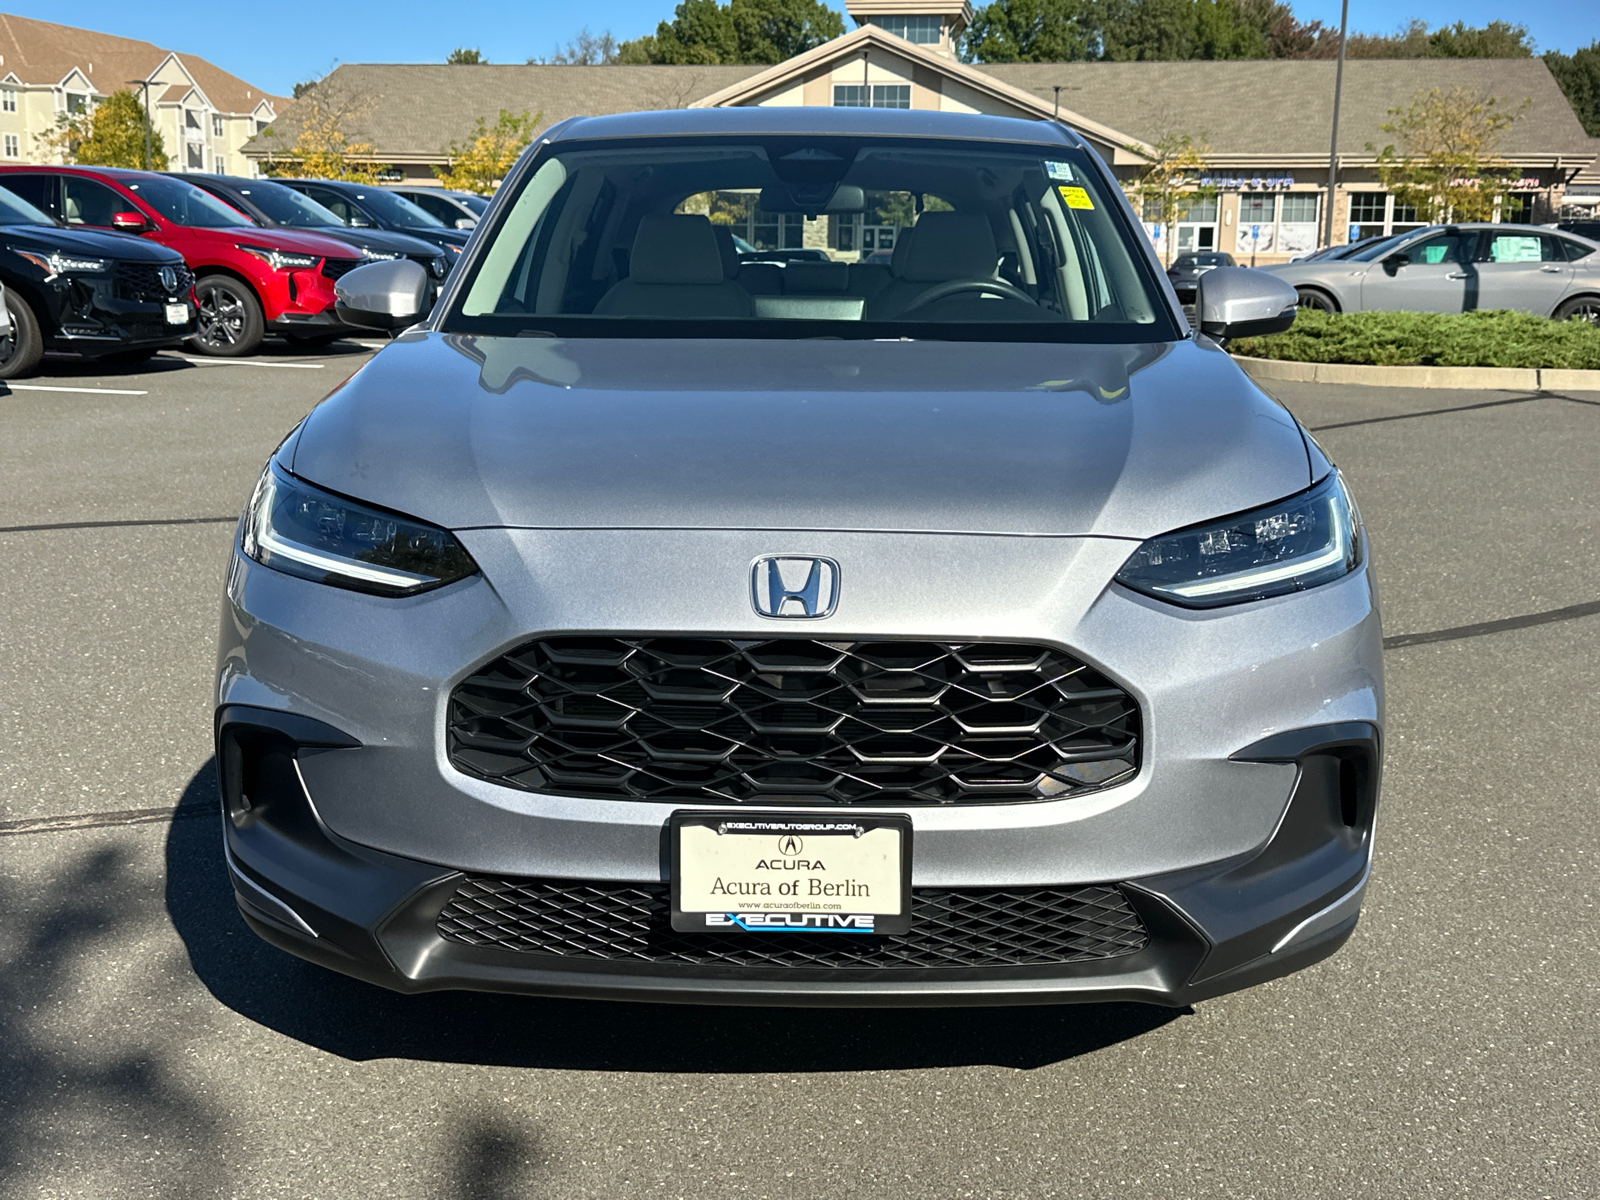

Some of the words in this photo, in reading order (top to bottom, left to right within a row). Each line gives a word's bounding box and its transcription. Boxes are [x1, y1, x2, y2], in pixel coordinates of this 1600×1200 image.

[1265, 170, 1294, 187] SPA
[726, 822, 857, 831] EXECUTIVEAUTOGROUP.COM
[755, 859, 826, 871] ACURA
[710, 877, 772, 896] Acura
[778, 877, 801, 896] of
[807, 878, 871, 897] Berlin
[738, 902, 842, 910] www.acuraofberlin.com
[705, 913, 875, 928] EXECUTIVE
